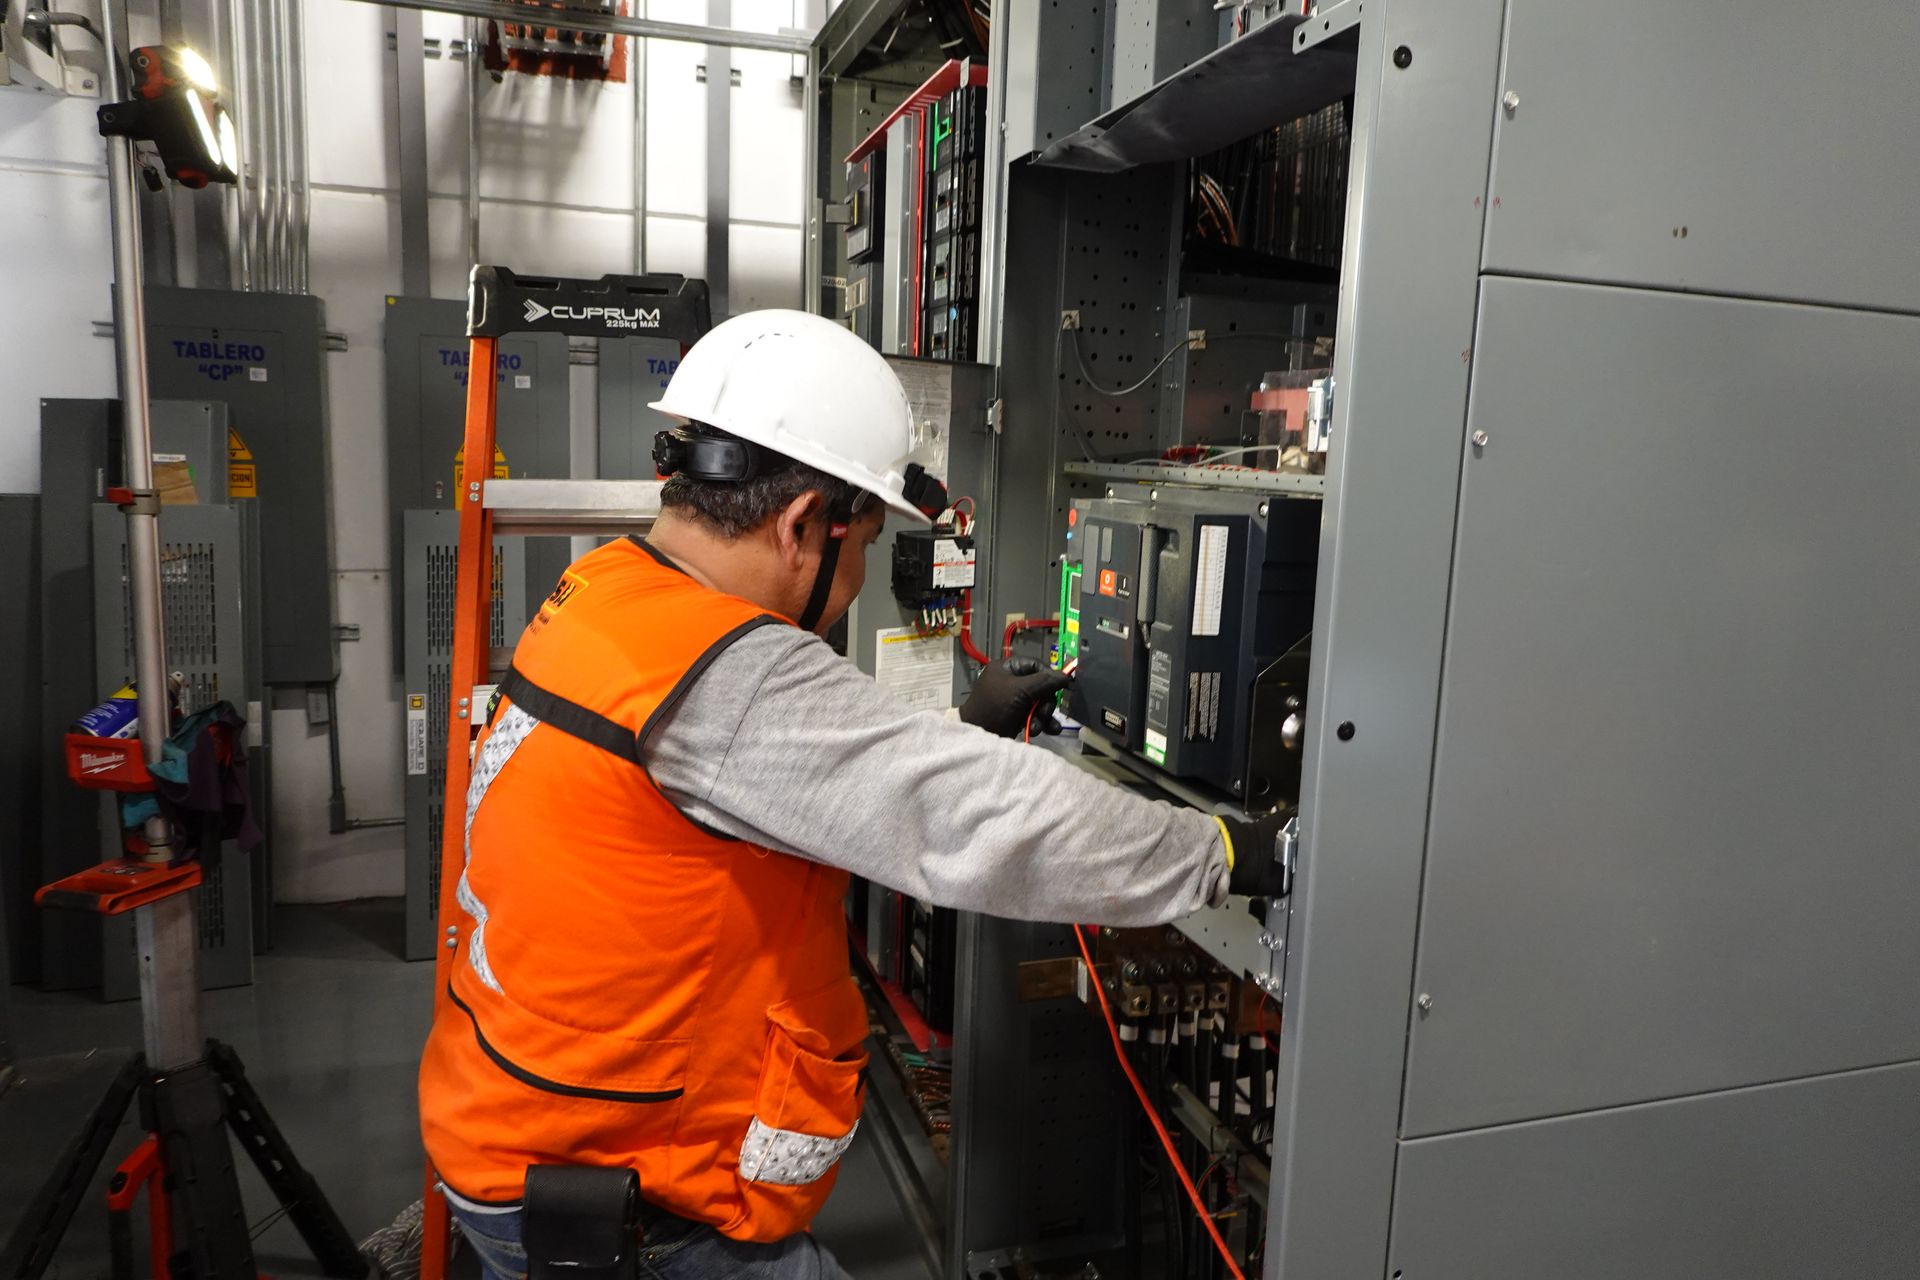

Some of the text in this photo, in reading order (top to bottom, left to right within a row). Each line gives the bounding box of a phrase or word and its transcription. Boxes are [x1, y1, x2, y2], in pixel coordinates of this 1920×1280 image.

[551, 306, 660, 320] CUPRUM
[606, 320, 637, 329] 225kg
[173, 341, 265, 361] TABLERO
